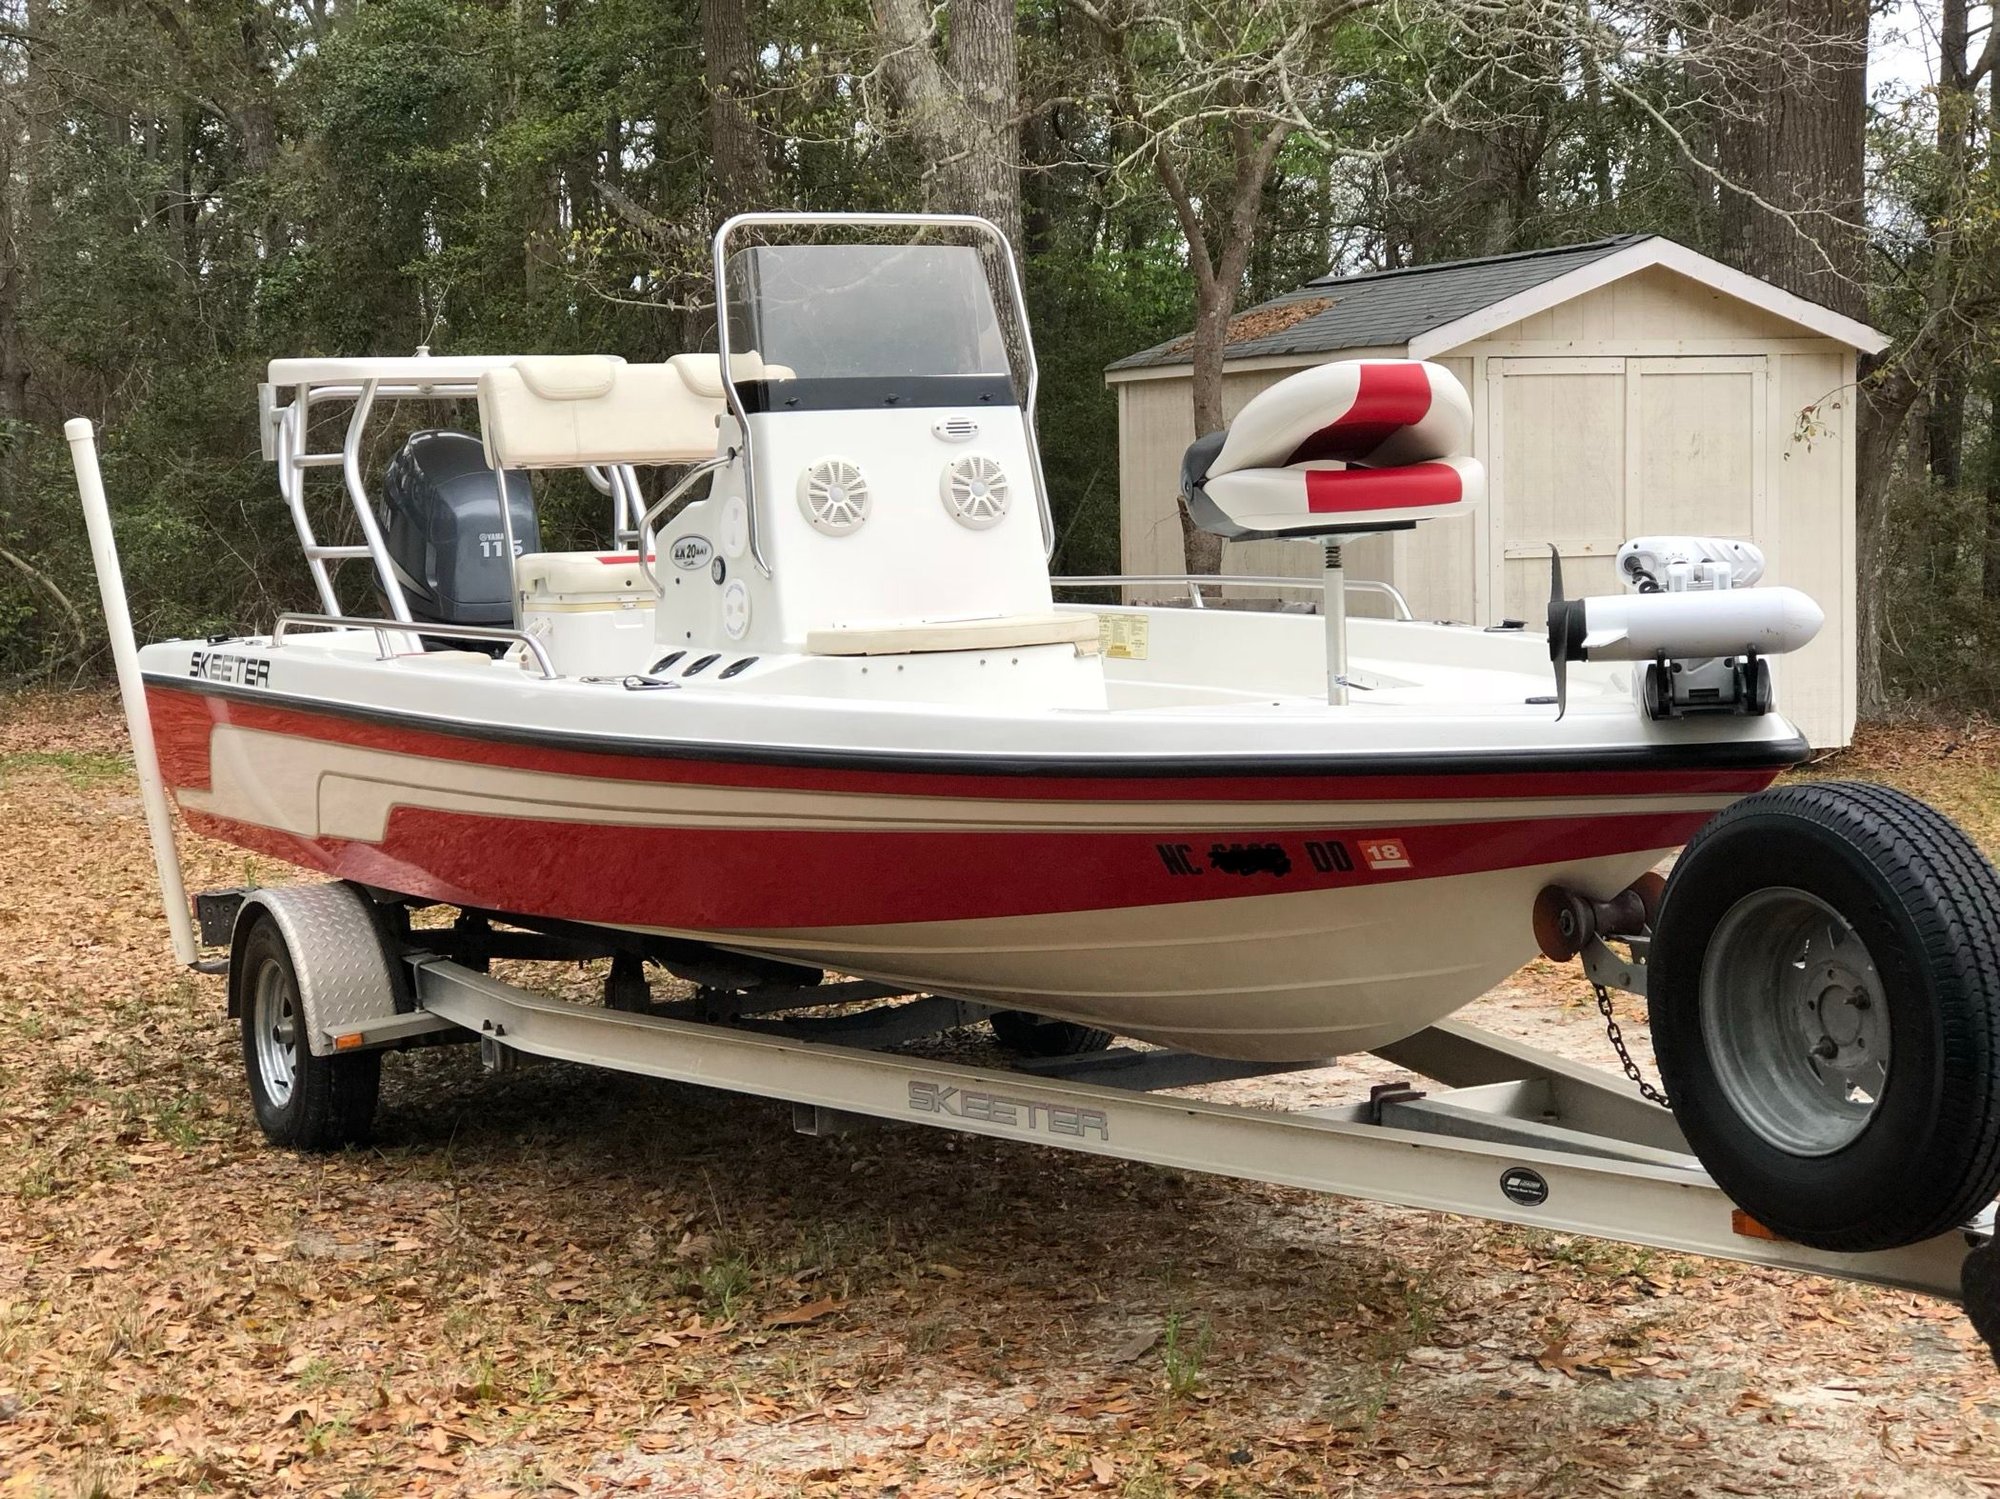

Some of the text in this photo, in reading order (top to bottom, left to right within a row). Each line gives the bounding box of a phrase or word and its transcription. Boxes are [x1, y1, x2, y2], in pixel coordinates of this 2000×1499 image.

[480, 539, 523, 558] 115
[190, 651, 270, 688] SKEETER
[1155, 843, 1204, 875] NC
[1367, 845, 1401, 860] 18
[907, 1080, 1109, 1140] SKEETER
